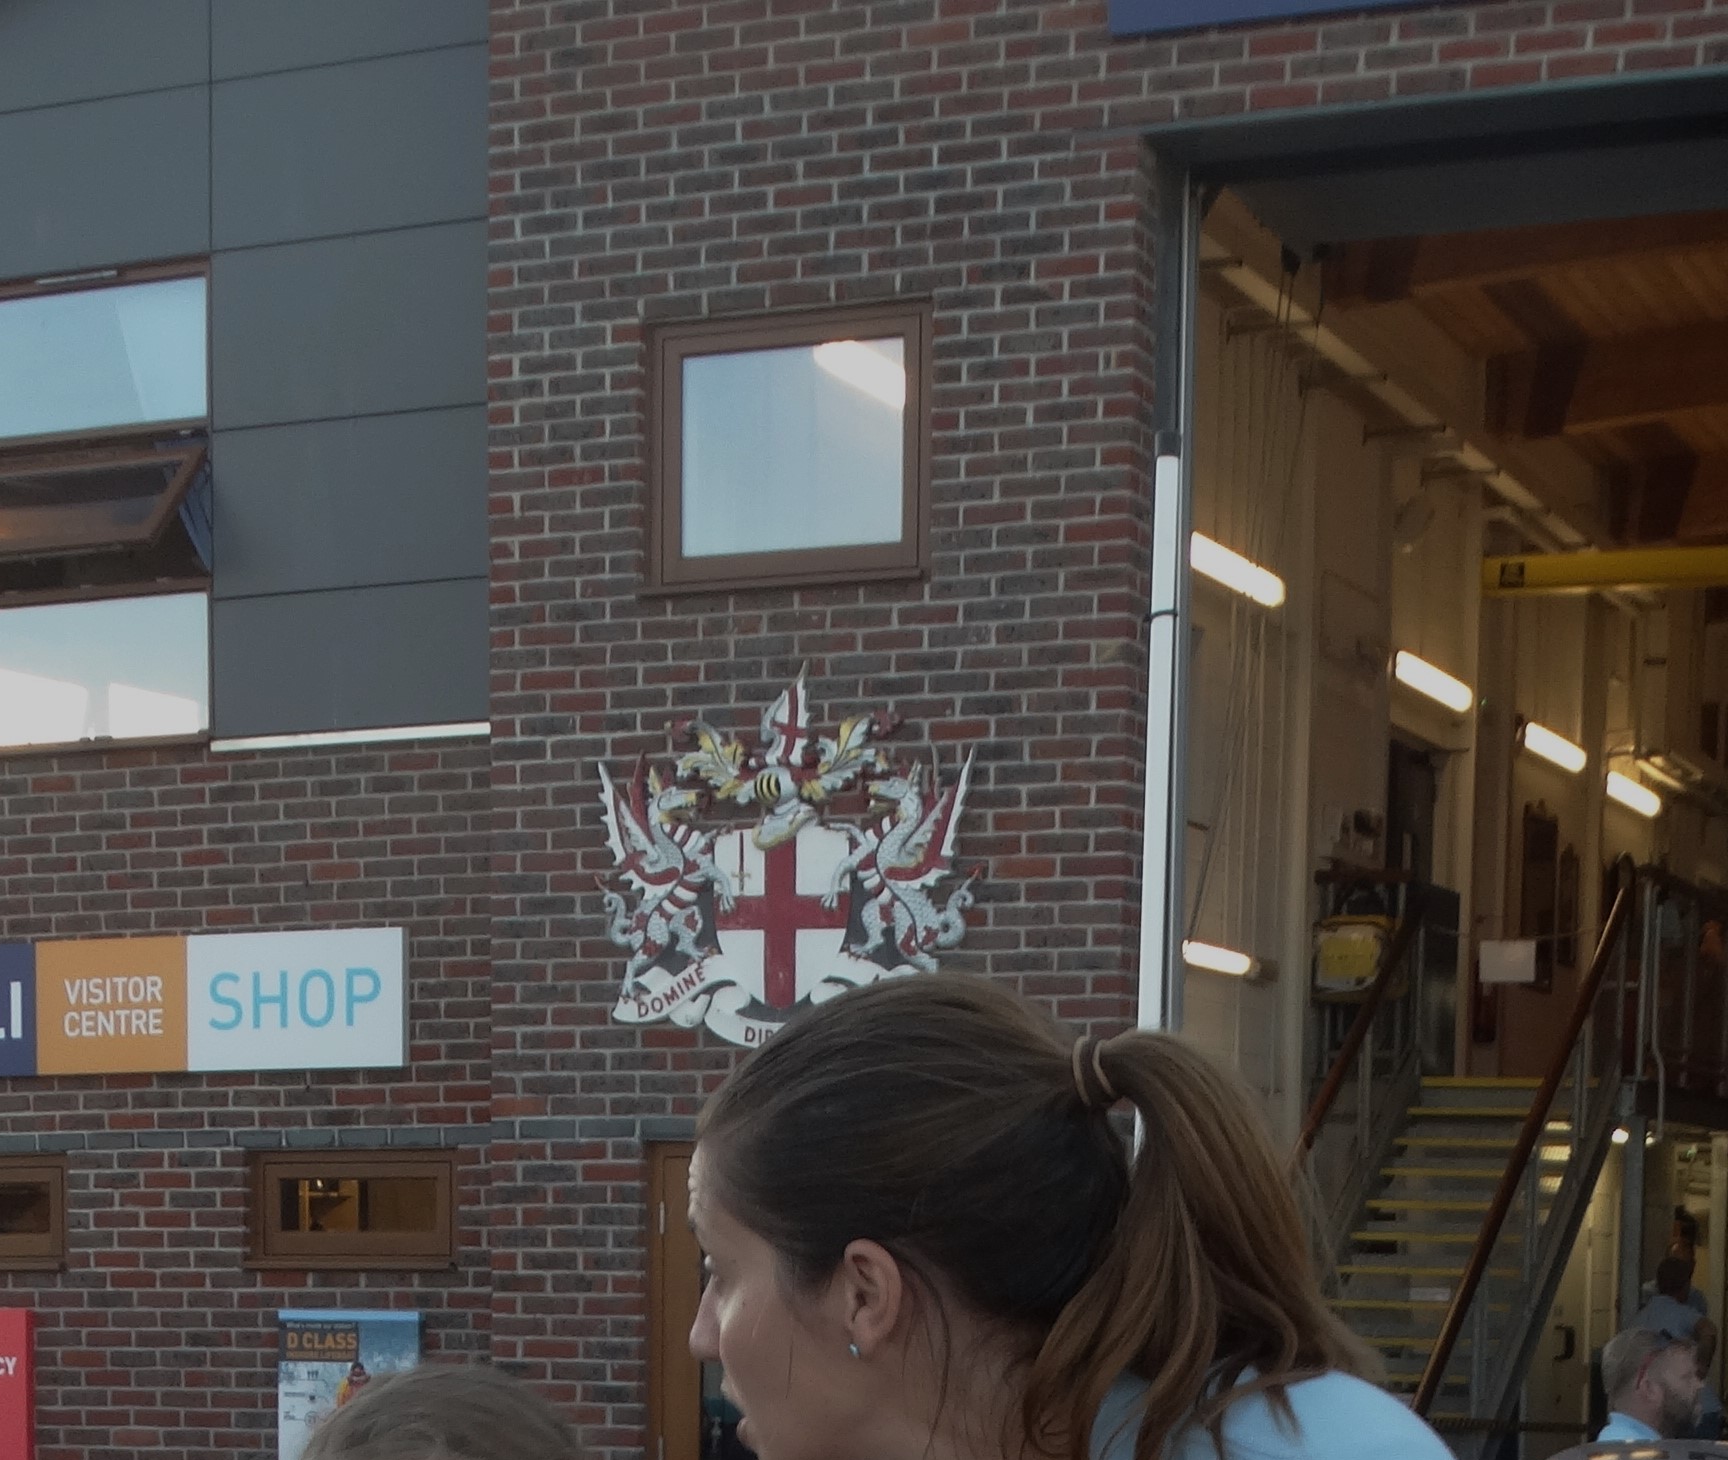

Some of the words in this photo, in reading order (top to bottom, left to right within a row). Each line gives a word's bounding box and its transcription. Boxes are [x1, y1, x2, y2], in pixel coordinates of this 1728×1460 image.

[63, 975, 163, 1006] VISITOR
[208, 967, 382, 1030] SHOP
[637, 967, 706, 1019] DOMINE
[63, 1007, 163, 1038] CENTRE
[286, 1332, 299, 1349] D
[302, 1331, 357, 1349] CLASS
